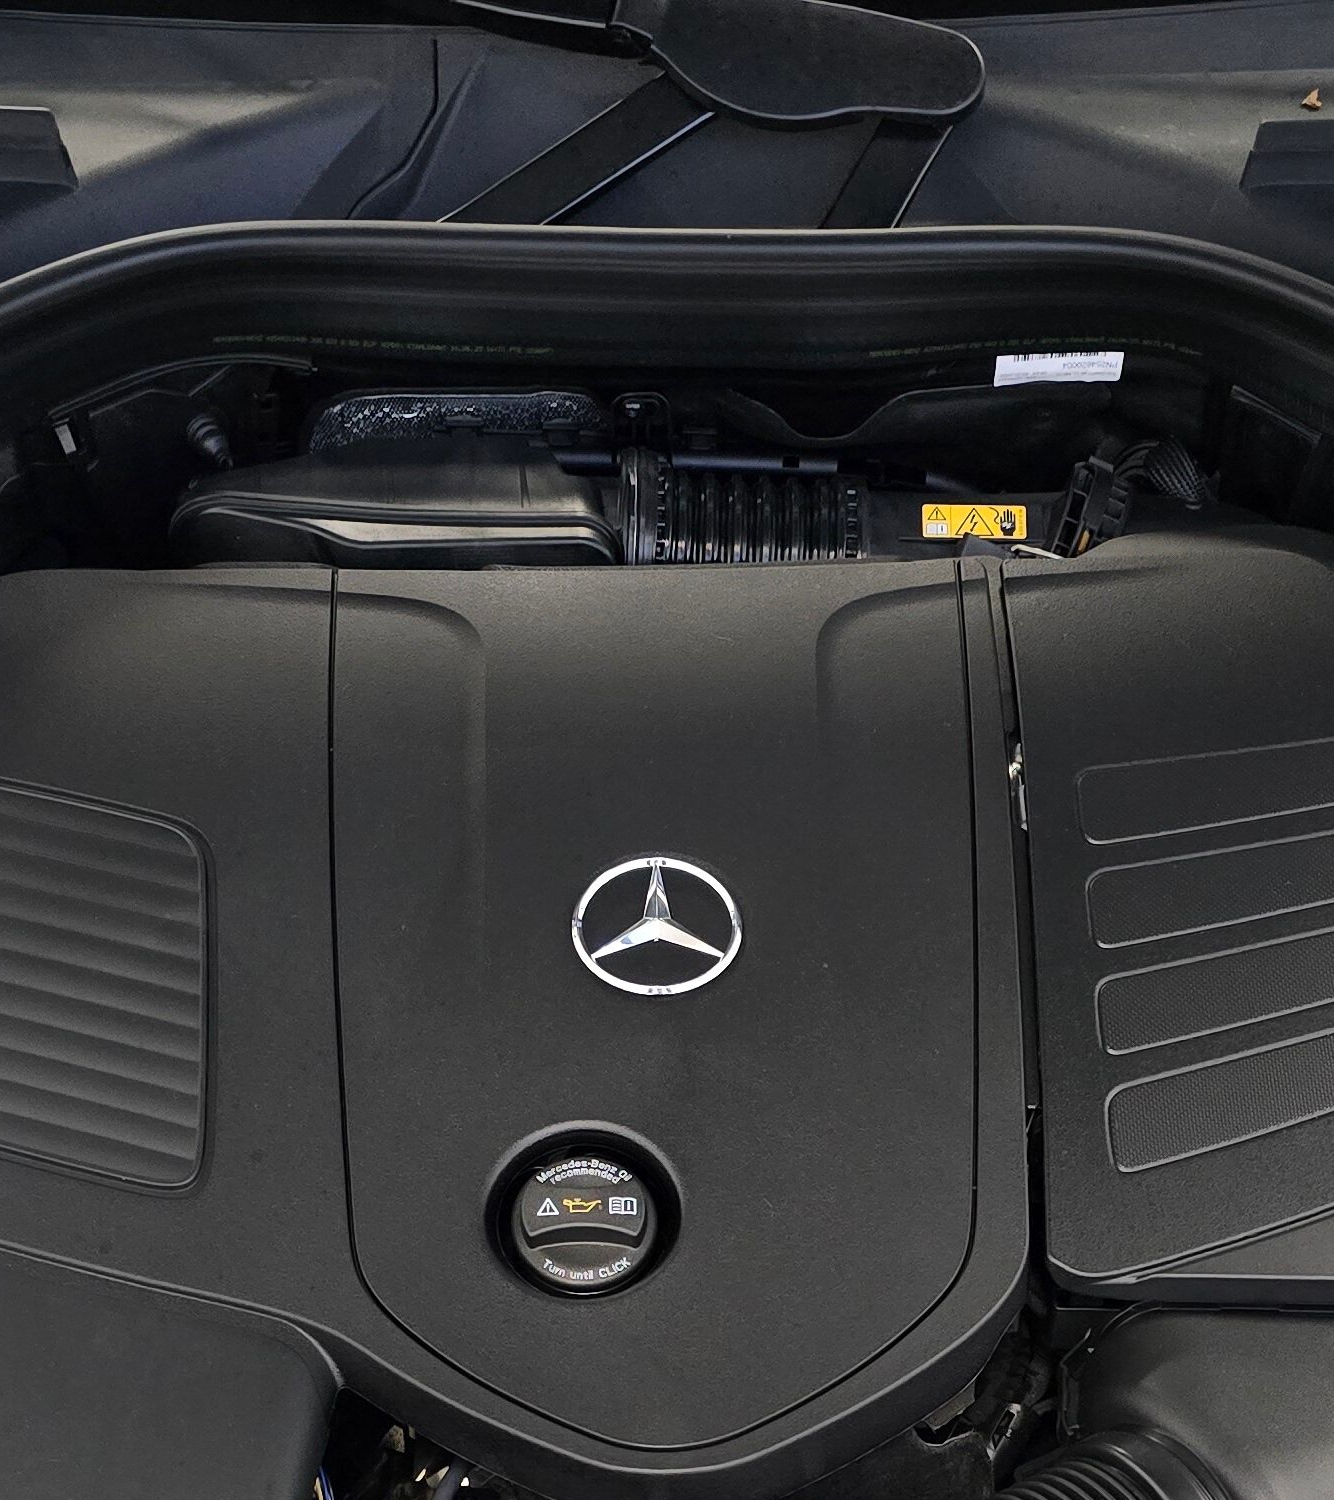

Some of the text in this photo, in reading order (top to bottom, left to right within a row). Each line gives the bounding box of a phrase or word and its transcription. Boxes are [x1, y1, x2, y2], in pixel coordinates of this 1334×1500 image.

[535, 1159, 634, 1184] Mercedes-Benz Oil
[549, 1166, 622, 1186] recommended
[542, 1256, 632, 1281] Turn until CLICK
